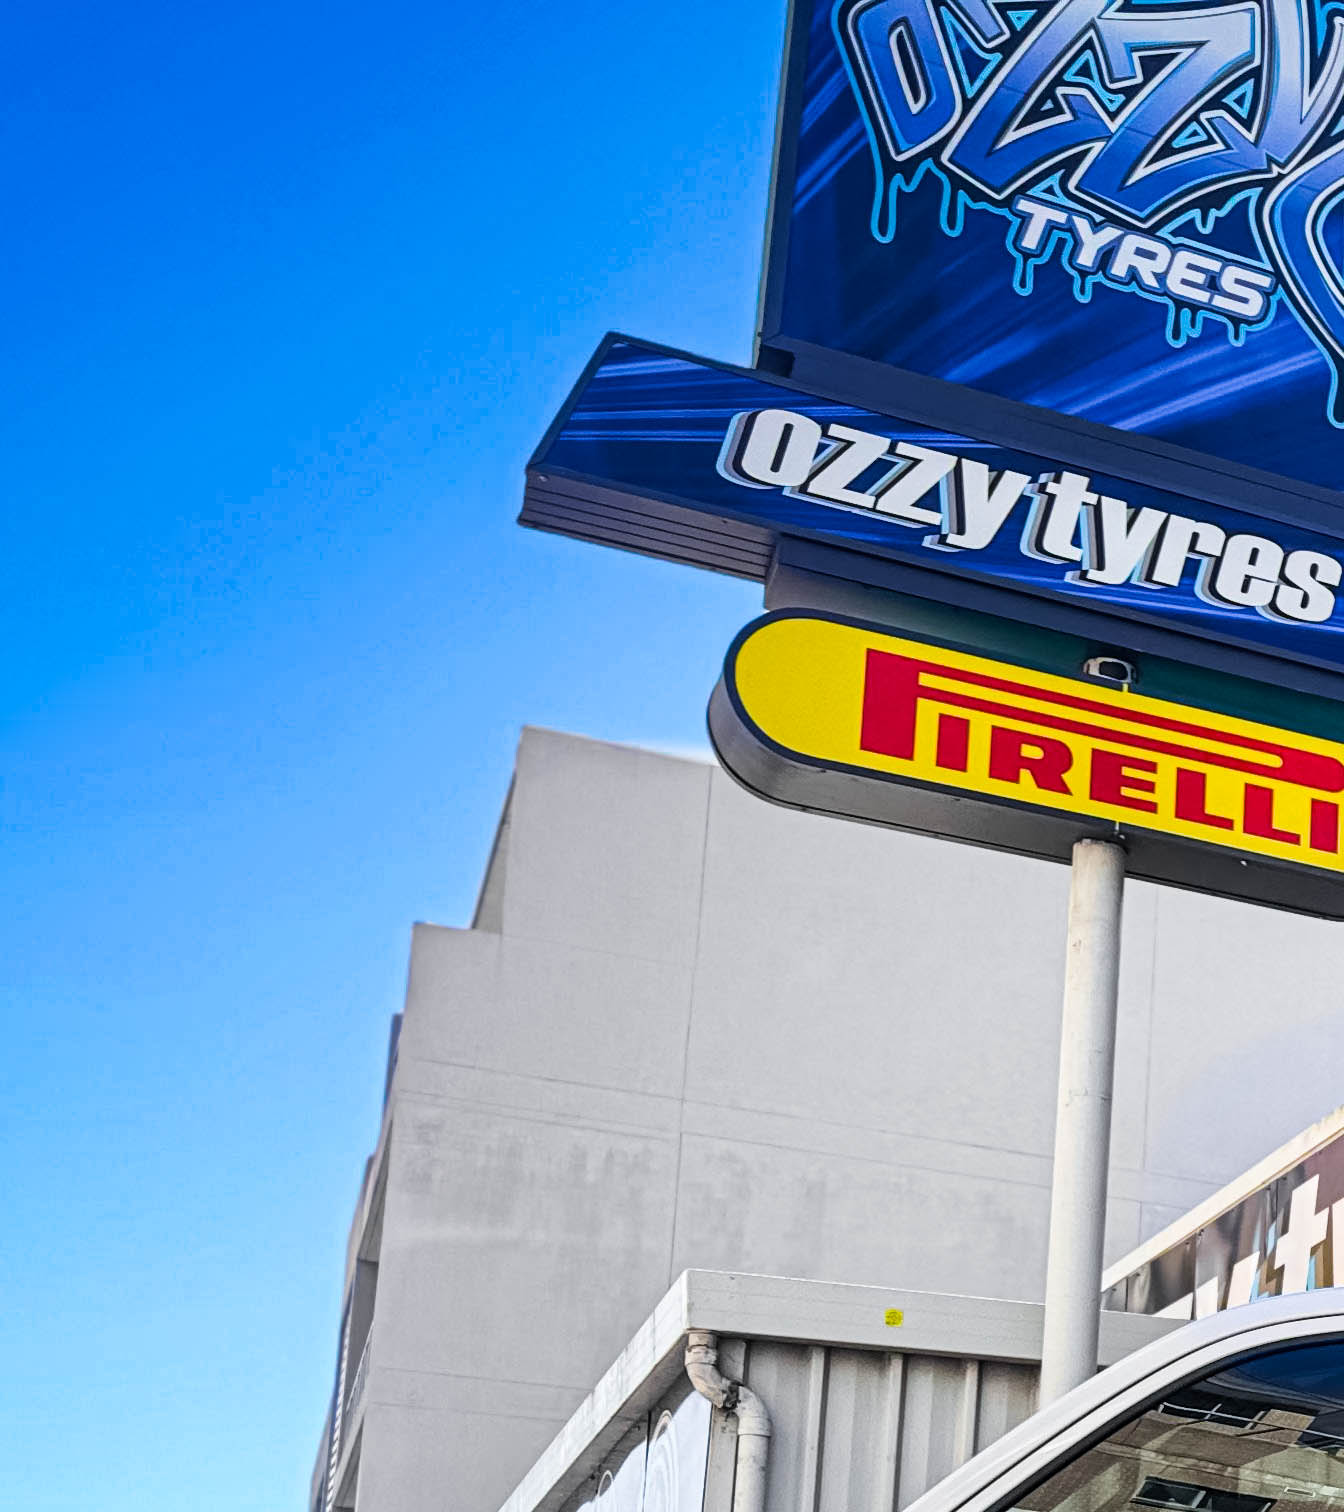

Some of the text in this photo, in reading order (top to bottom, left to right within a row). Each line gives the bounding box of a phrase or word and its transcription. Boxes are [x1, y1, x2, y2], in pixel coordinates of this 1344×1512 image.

[1014, 199, 1274, 322] TYRES
[738, 409, 1344, 624] ozzy tyres
